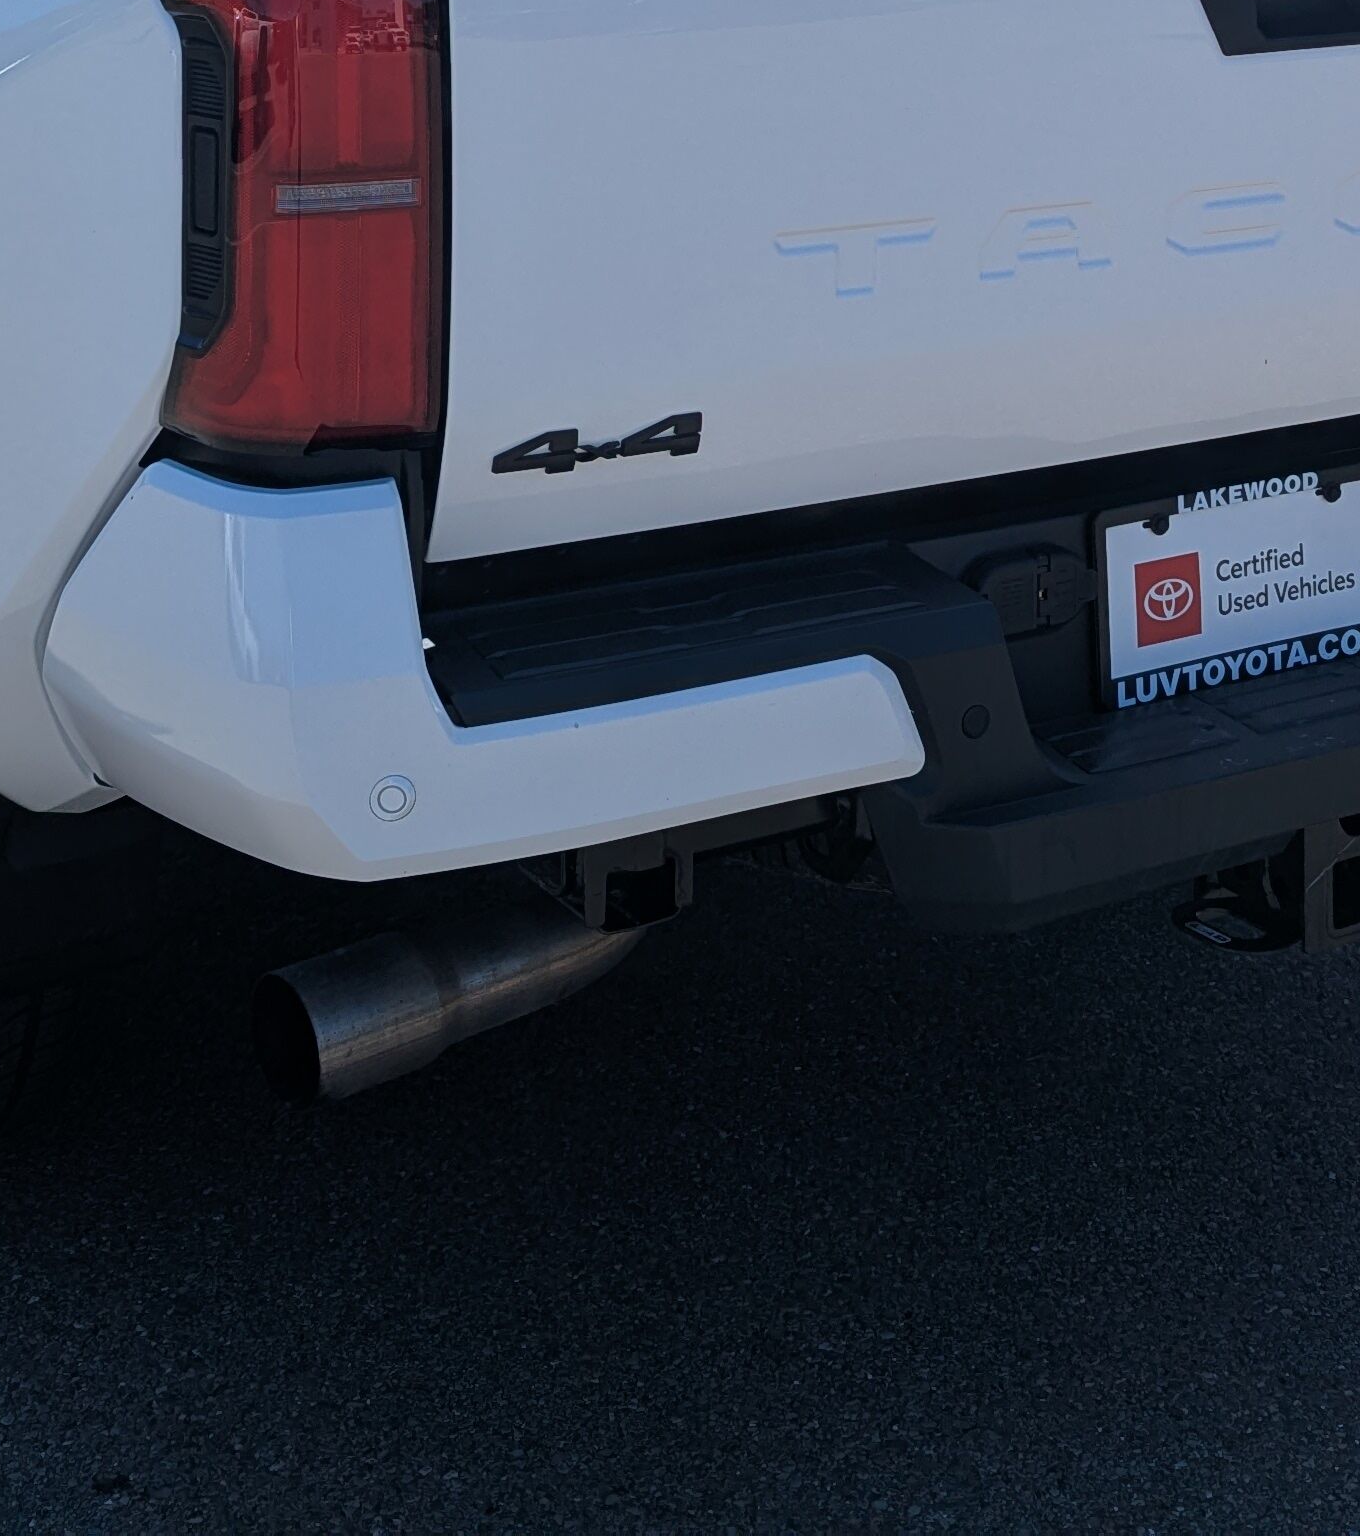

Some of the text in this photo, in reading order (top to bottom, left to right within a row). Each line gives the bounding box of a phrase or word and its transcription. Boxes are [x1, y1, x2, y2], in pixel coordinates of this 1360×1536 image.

[1177, 471, 1319, 514] LAKEWOOD
[1216, 543, 1304, 581] Certified
[1218, 571, 1355, 615] Used Vehicles
